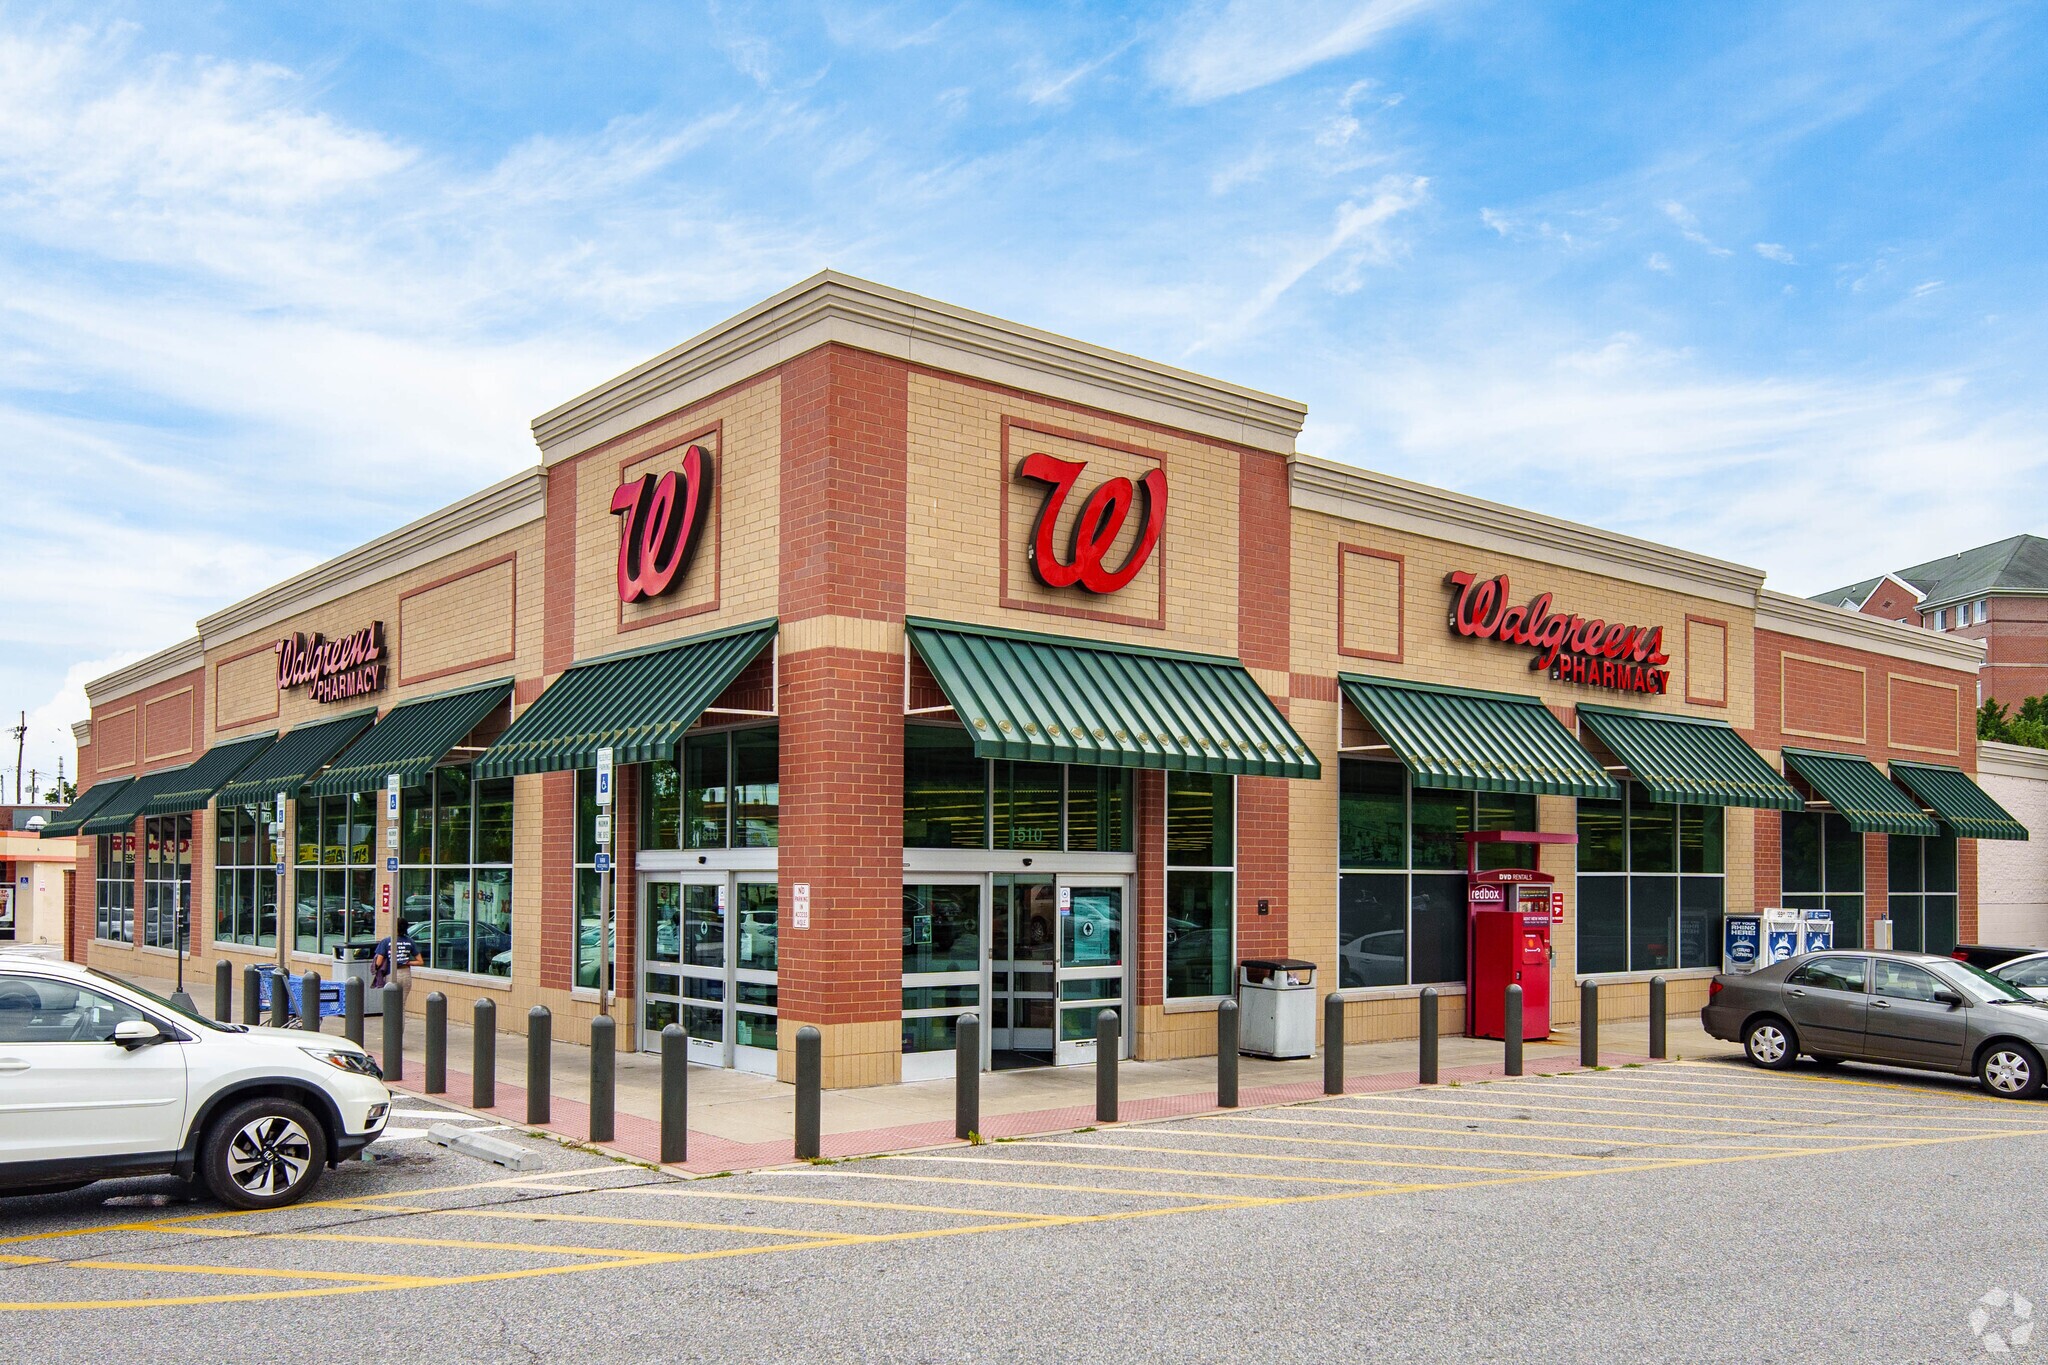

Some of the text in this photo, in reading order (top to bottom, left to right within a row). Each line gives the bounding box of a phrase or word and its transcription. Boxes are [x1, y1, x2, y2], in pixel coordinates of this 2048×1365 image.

[610, 445, 712, 602] W
[1015, 452, 1168, 594] W
[1444, 570, 1670, 670] Walgreens
[275, 620, 382, 699] Walgreens
[1556, 654, 1670, 695] PHARMACY
[318, 665, 382, 703] PHARMACY
[1010, 827, 1042, 842] 1510
[797, 885, 806, 894] NO
[1471, 888, 1500, 900] redbox
